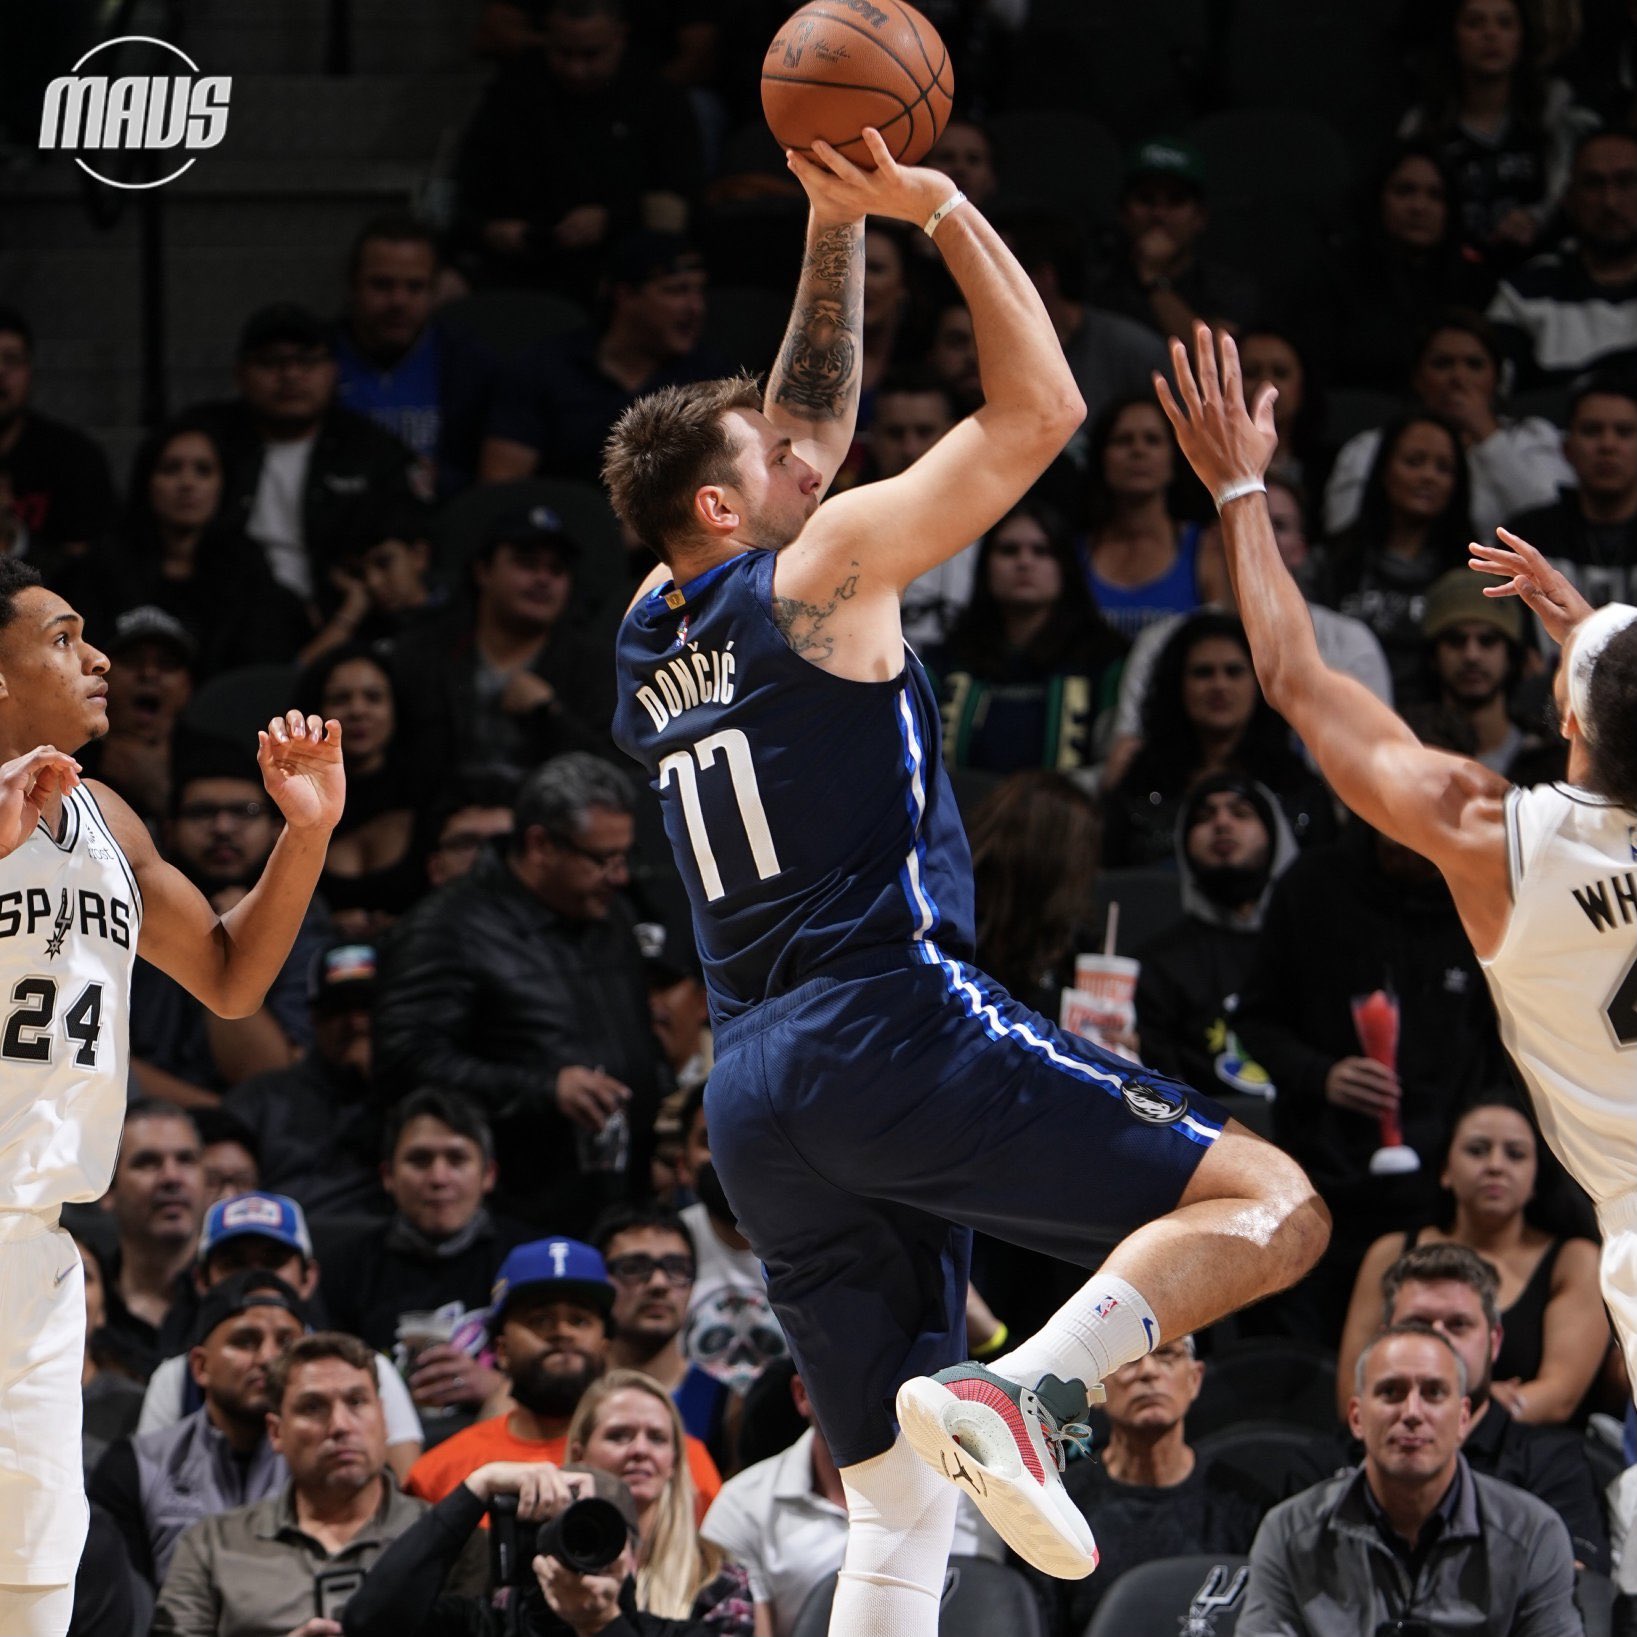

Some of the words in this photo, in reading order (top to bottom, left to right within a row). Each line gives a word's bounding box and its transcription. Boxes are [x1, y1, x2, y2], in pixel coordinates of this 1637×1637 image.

[635, 640, 736, 733] DONČIĆ
[658, 728, 782, 902] 77
[0, 974, 104, 1070] 24
